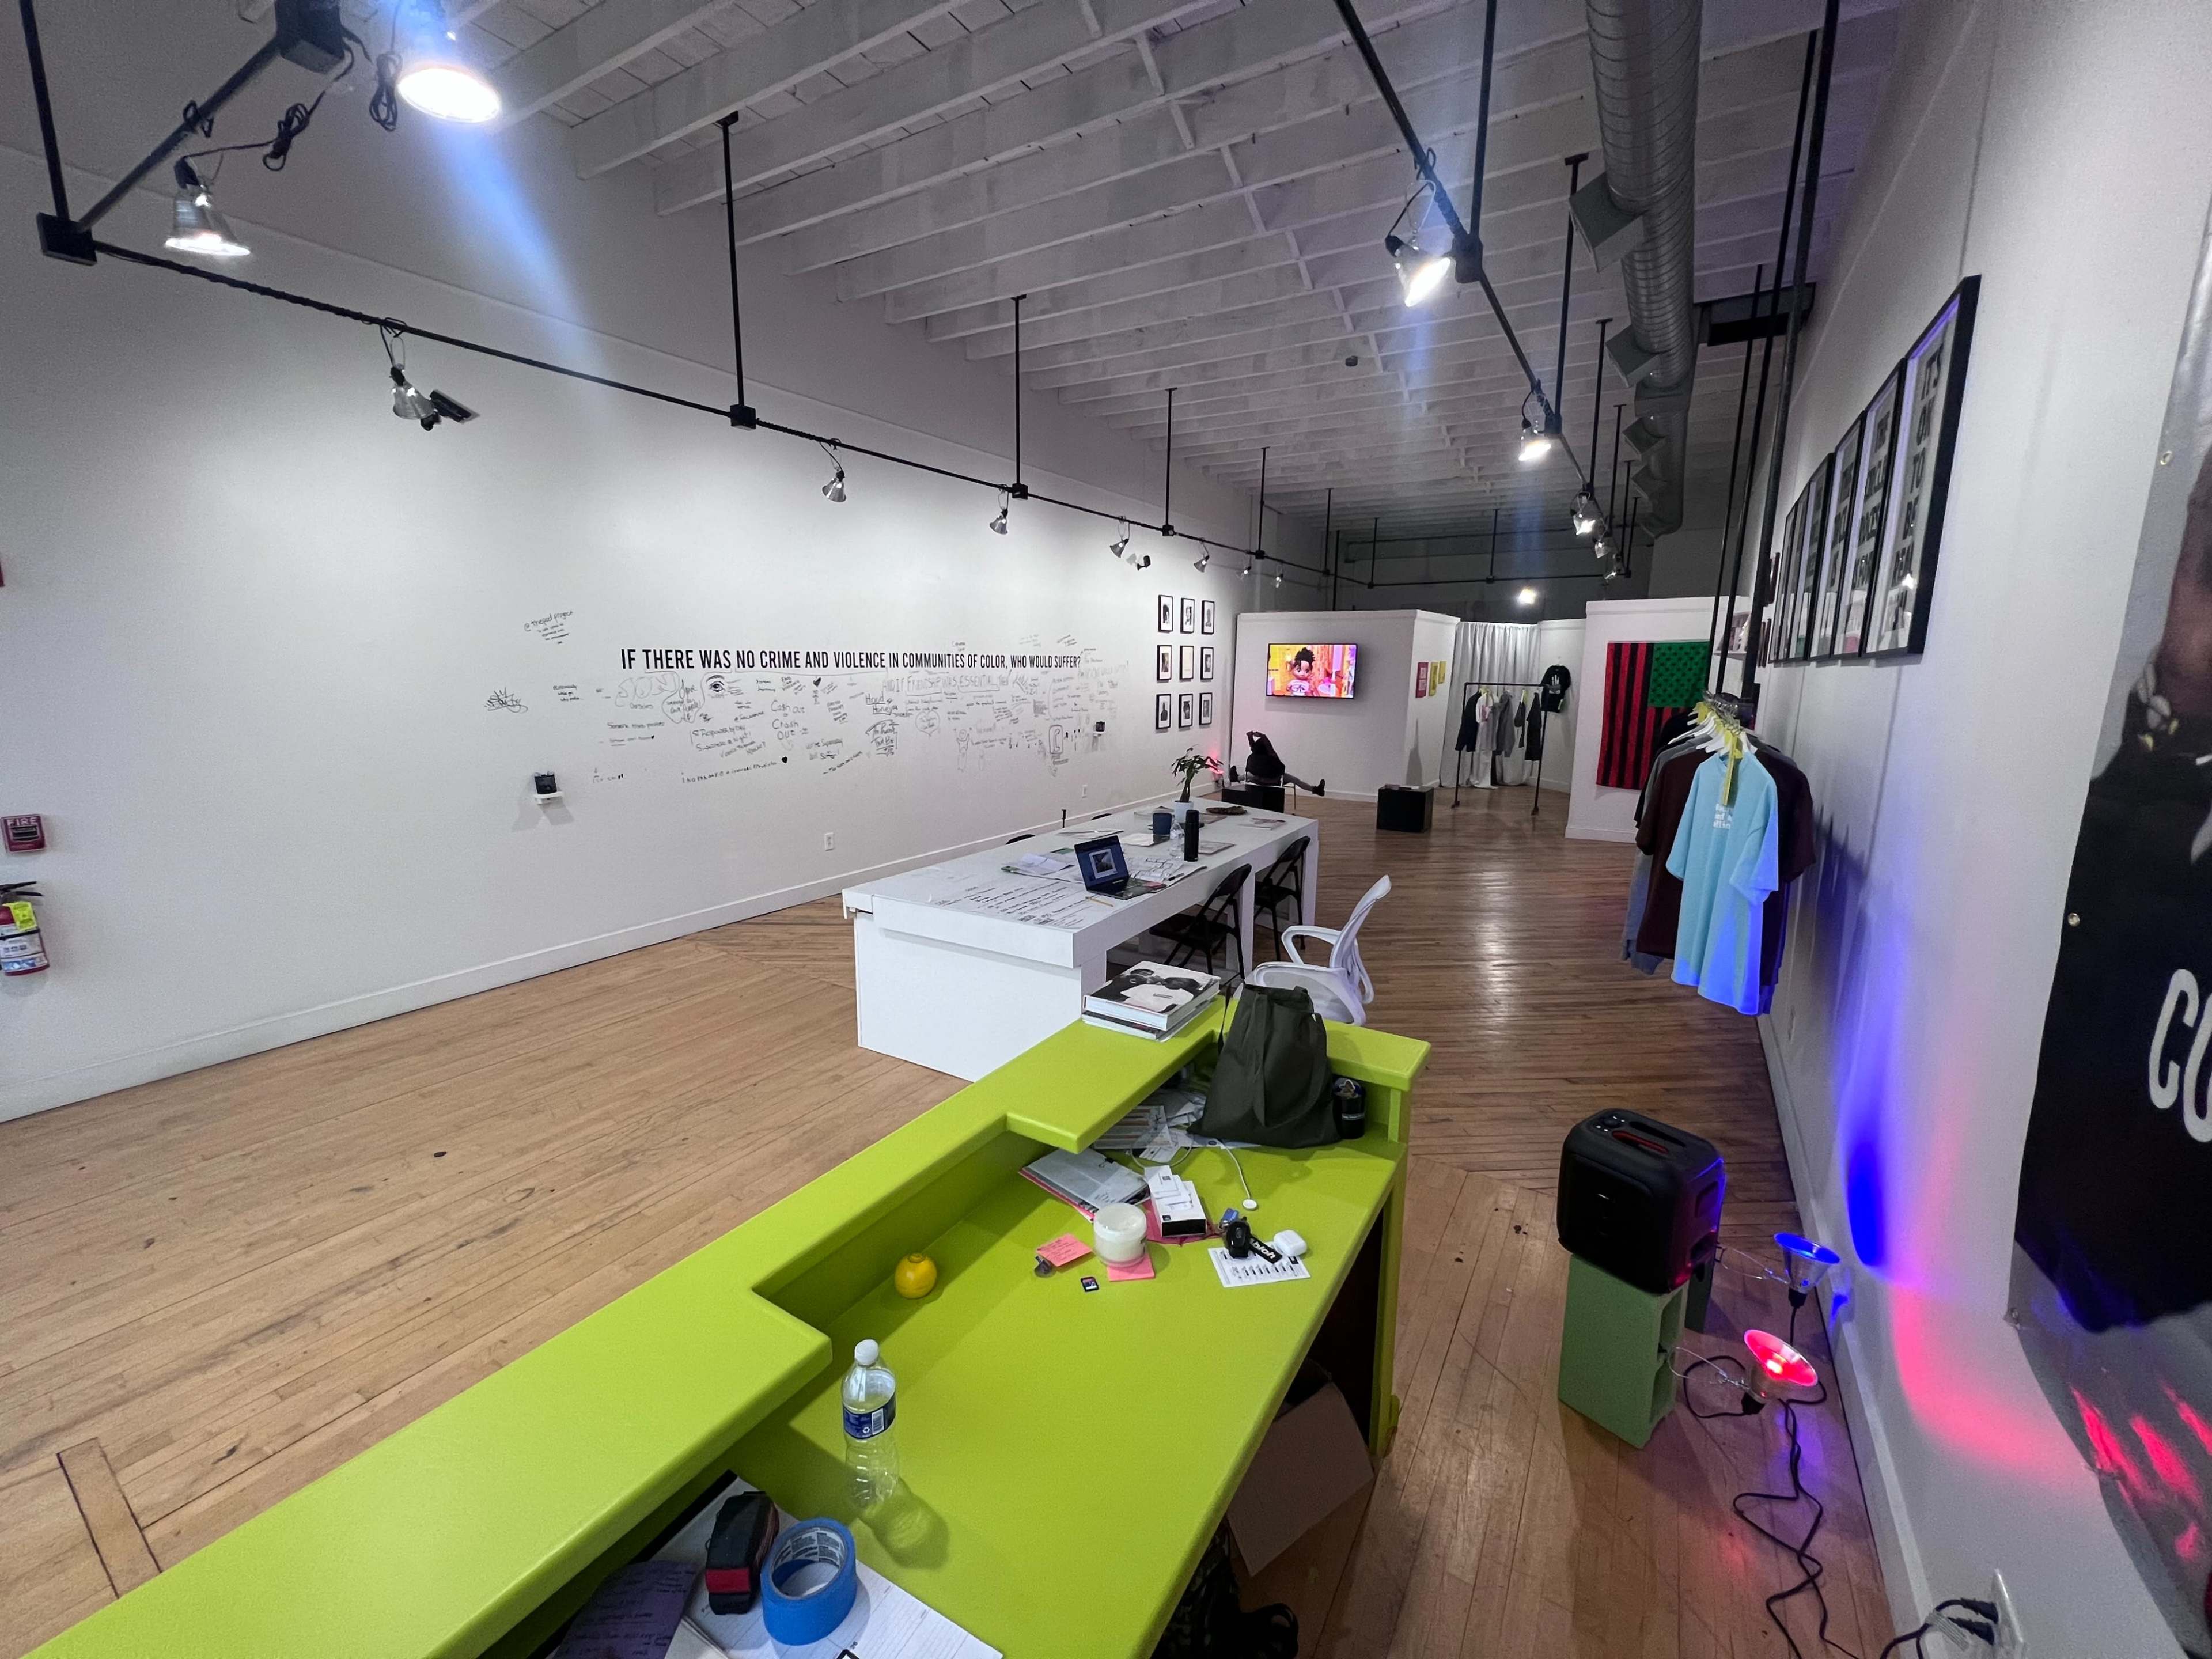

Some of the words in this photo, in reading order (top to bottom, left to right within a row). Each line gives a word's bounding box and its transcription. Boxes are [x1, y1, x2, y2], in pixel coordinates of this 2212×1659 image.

[621, 649, 636, 669] IF
[642, 649, 695, 669] THERE
[699, 649, 731, 669] WAS
[736, 650, 755, 669] NO
[760, 650, 801, 669] CRIME
[805, 651, 828, 668] AND
[834, 652, 885, 668] VIOLENCE
[889, 653, 899, 668] IN
[903, 653, 965, 668] COMMUNITIES
[967, 654, 978, 668] OF
[980, 654, 1008, 669] COLOR,
[1010, 655, 1027, 668] WHO
[1029, 656, 1052, 668] WOULD
[1054, 656, 1081, 668] SUFFER?
[6, 817, 37, 825] FIRE
